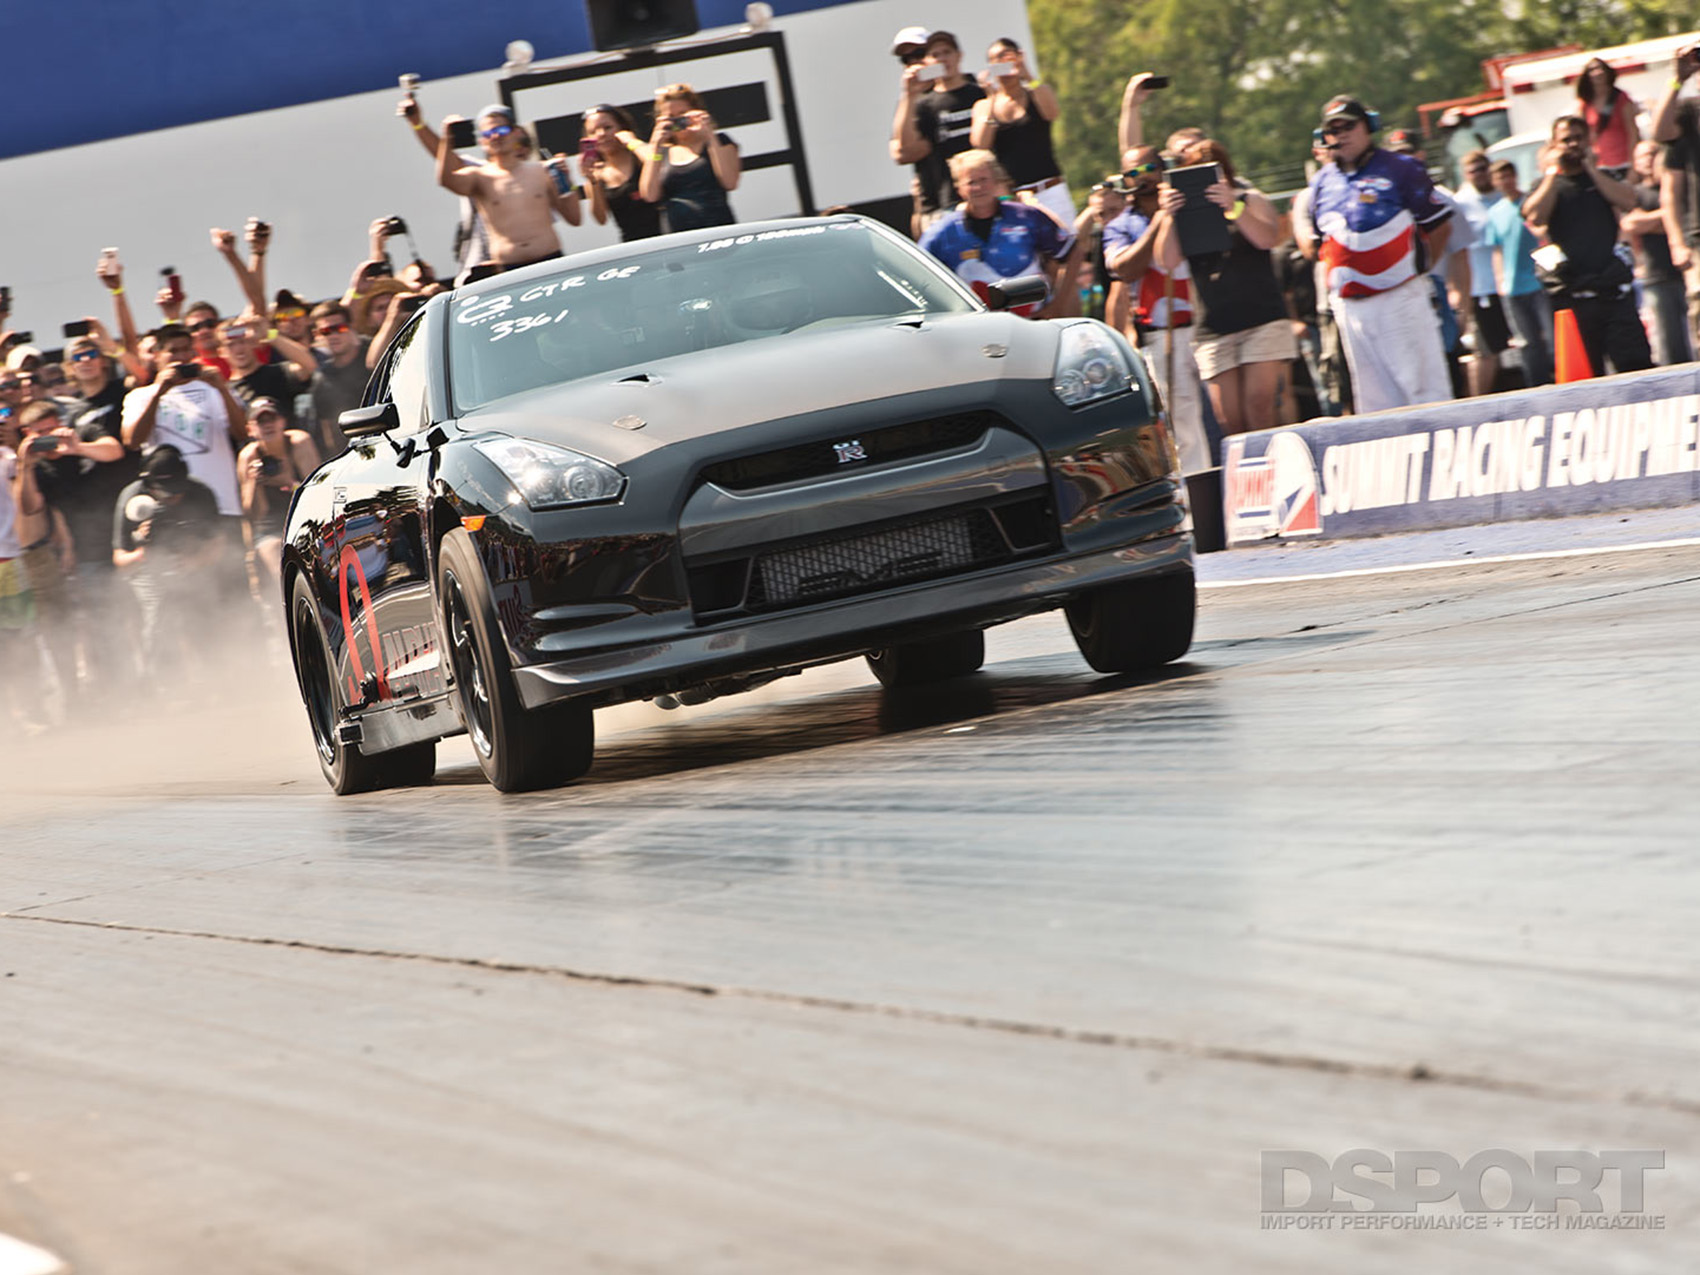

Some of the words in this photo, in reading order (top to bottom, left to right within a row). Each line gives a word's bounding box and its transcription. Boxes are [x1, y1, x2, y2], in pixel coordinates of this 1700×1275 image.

[1322, 432, 1430, 515] SUMMIT
[1428, 415, 1546, 502] RACING
[1547, 394, 1700, 488] EQUIPME
